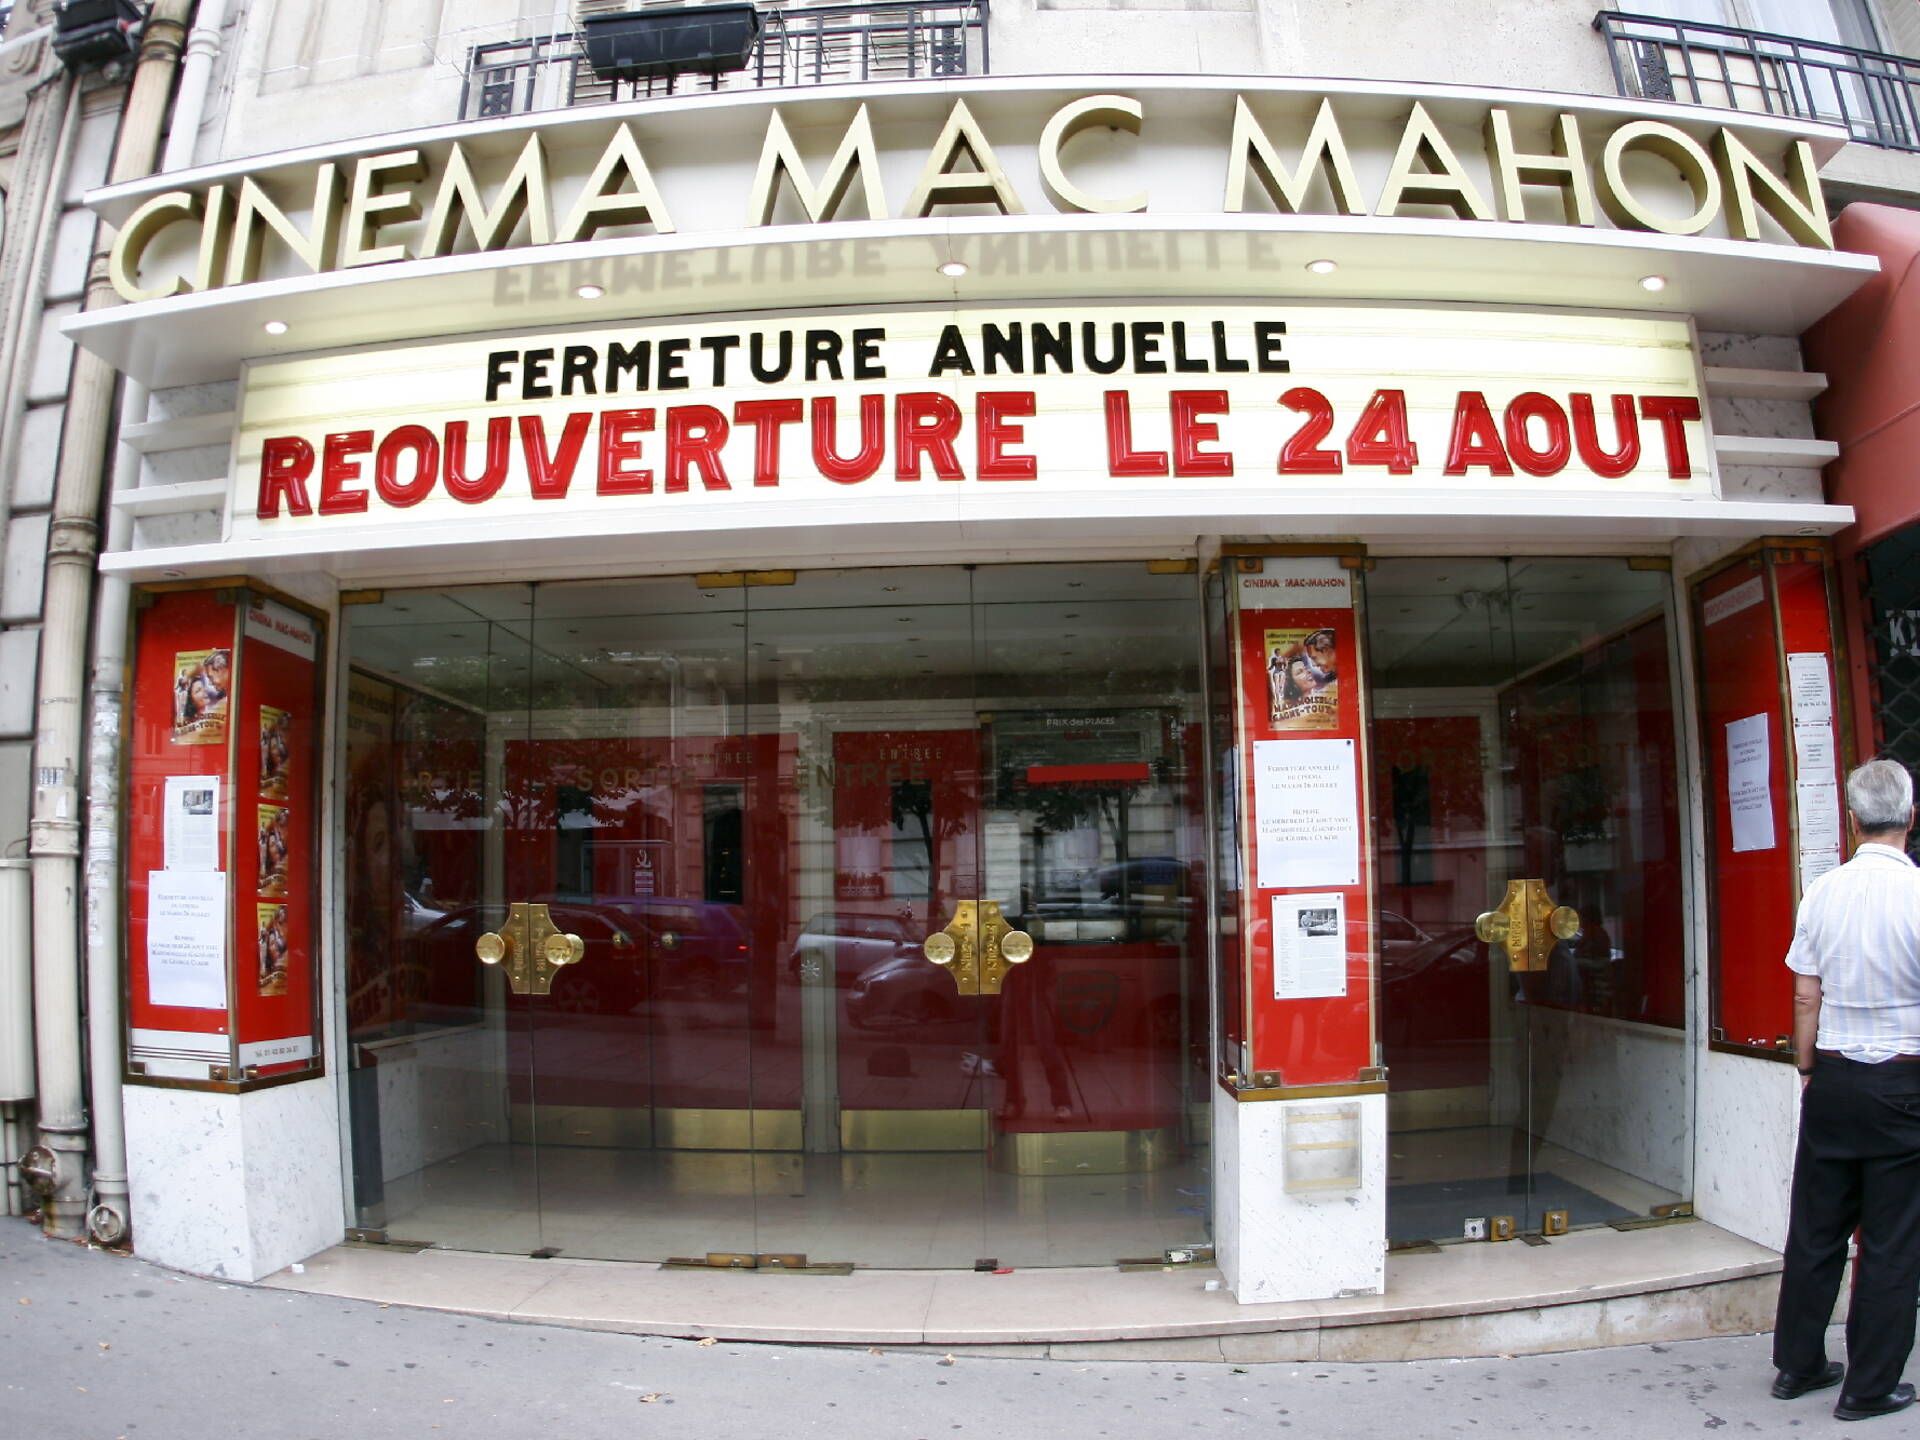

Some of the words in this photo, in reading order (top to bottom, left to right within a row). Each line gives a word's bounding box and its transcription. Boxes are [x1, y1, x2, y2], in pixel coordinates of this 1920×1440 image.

[108, 121, 676, 304] CINEMA
[746, 94, 1149, 229] MAC
[1223, 94, 1835, 250] MAHON
[486, 326, 887, 403] FERMETURE
[928, 320, 1290, 377] ANNUELLE
[256, 390, 1037, 520] REOUVERTURE
[1105, 389, 1233, 479] LE
[1277, 386, 1419, 477] 24
[1443, 390, 1703, 480] AOUT
[1243, 578, 1280, 588] CINEMA
[1285, 577, 1345, 588] MAC-MAHON
